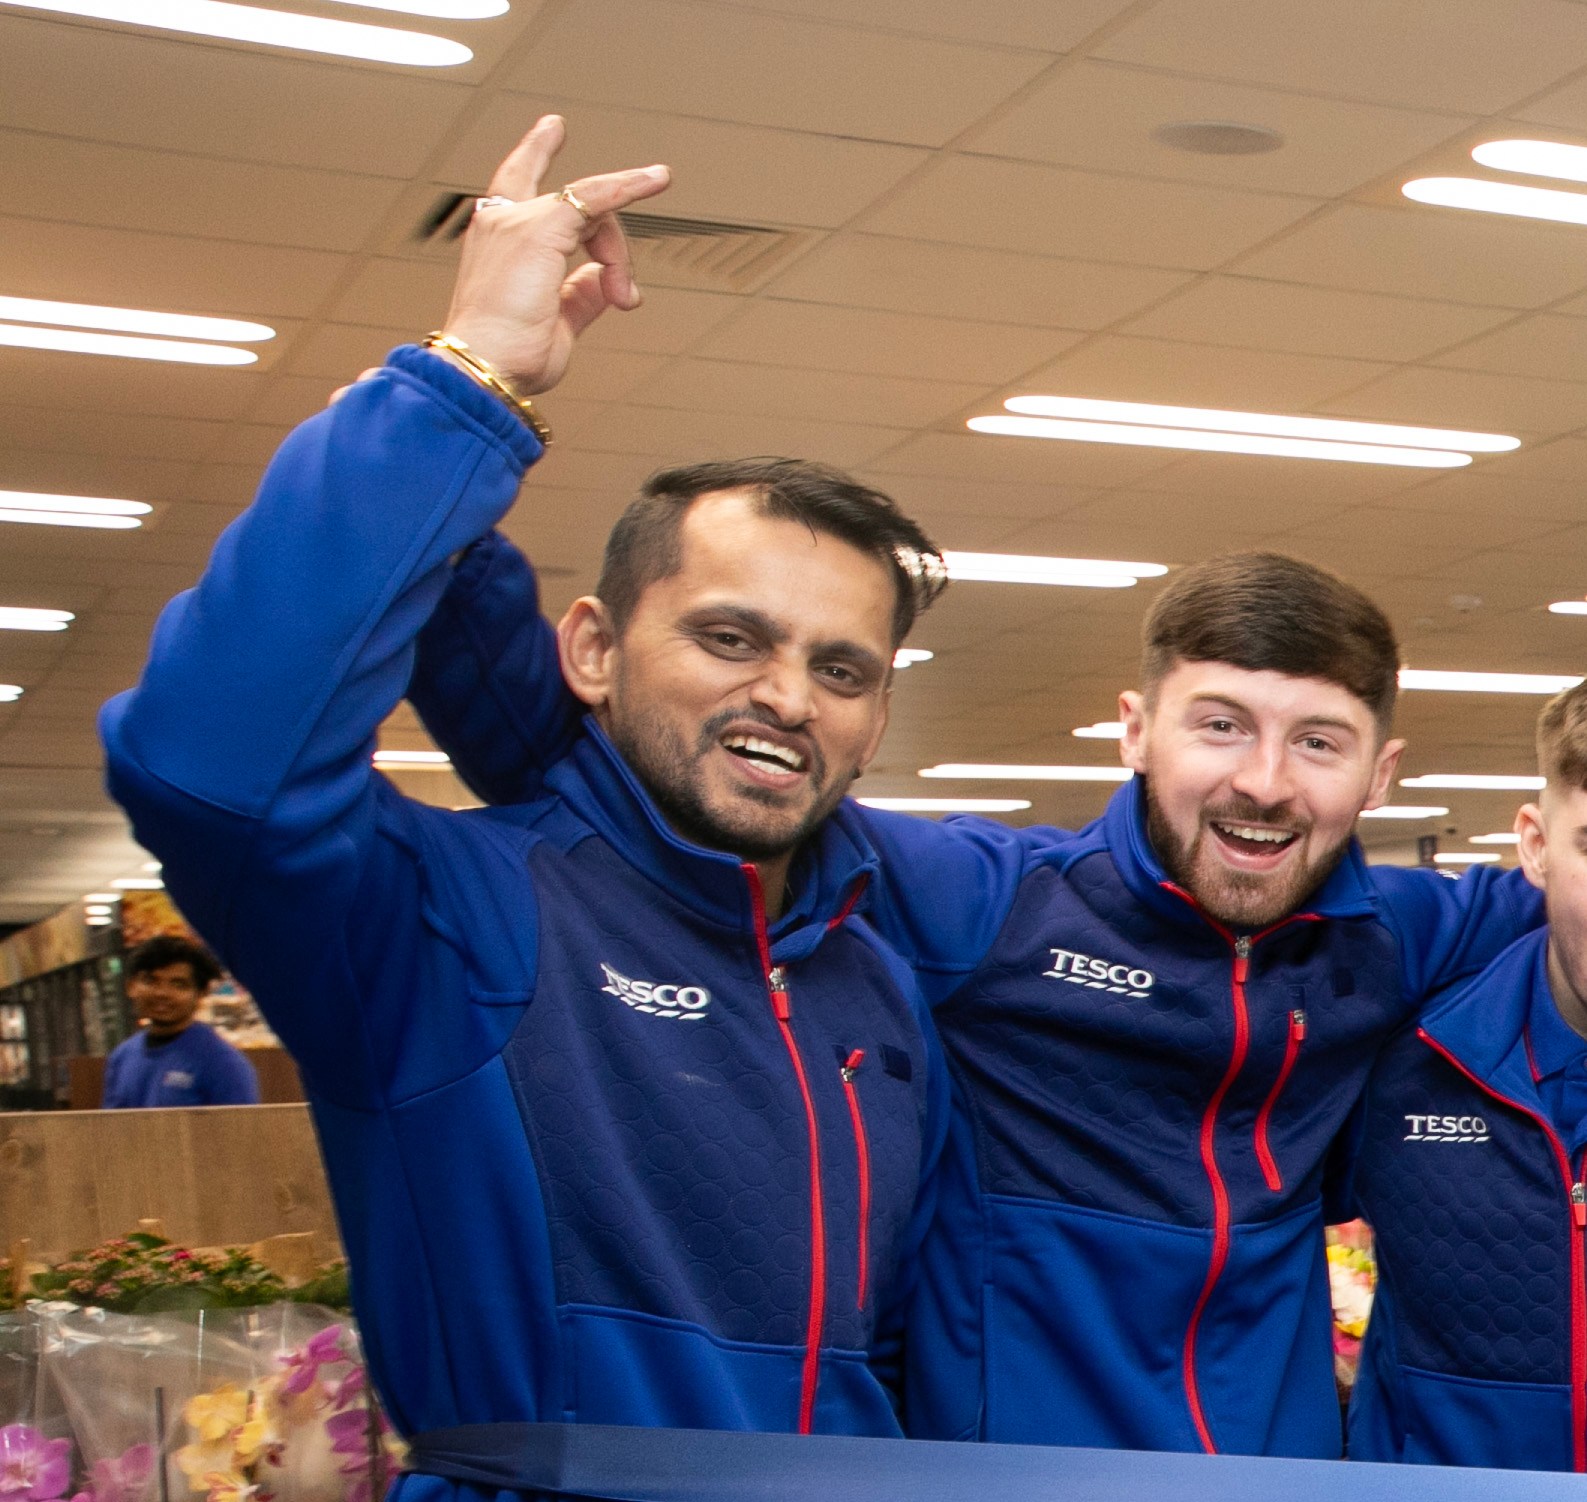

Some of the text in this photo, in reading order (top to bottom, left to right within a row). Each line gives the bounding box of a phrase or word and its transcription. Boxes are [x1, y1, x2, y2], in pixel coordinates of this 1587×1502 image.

[600, 963, 711, 1010] TESCO
[1050, 948, 1154, 989] TESCO
[1404, 1115, 1487, 1134] TESCO
